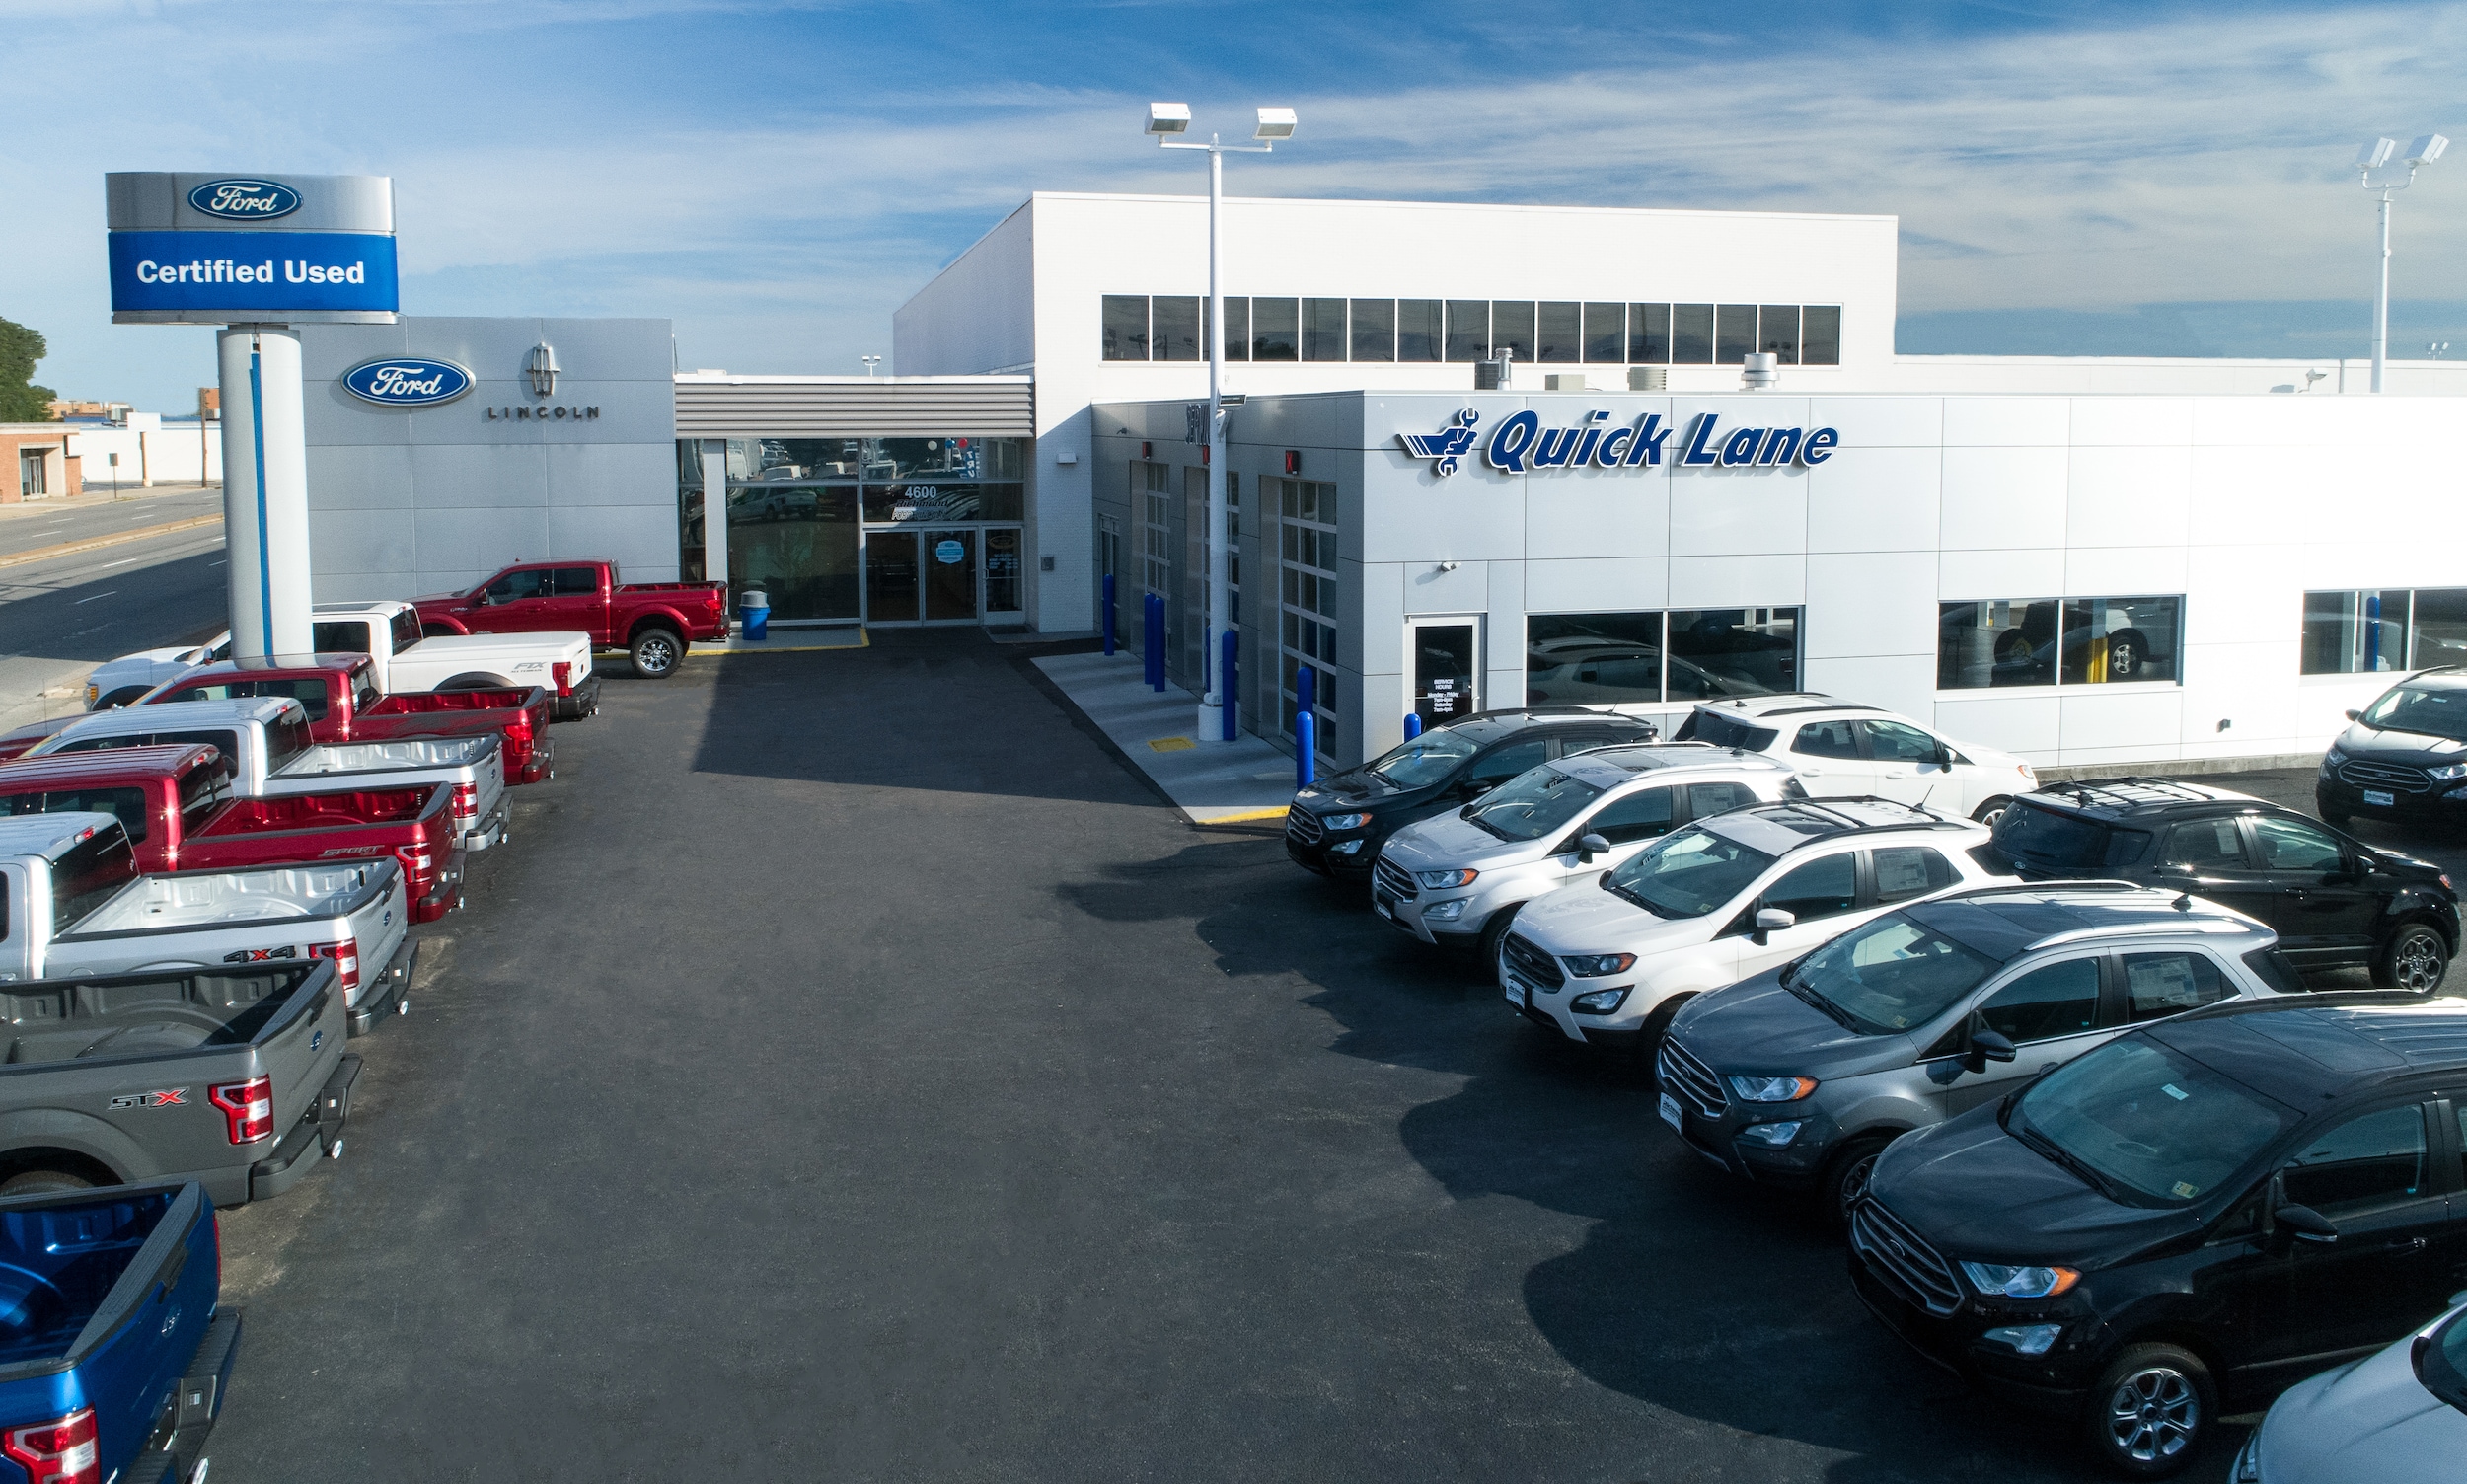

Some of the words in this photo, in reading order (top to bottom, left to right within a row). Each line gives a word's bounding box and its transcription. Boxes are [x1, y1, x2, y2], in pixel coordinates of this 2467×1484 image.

[210, 185, 278, 211] Ford
[137, 260, 273, 283] Certified
[285, 260, 364, 284] Used
[369, 366, 443, 395] Ford
[488, 406, 600, 419] LINCOLN
[1487, 408, 1677, 474] Quick
[1681, 411, 1840, 467] Lane
[905, 486, 937, 498] 4600
[318, 845, 385, 857] SPORT
[106, 1086, 191, 1112] STX
